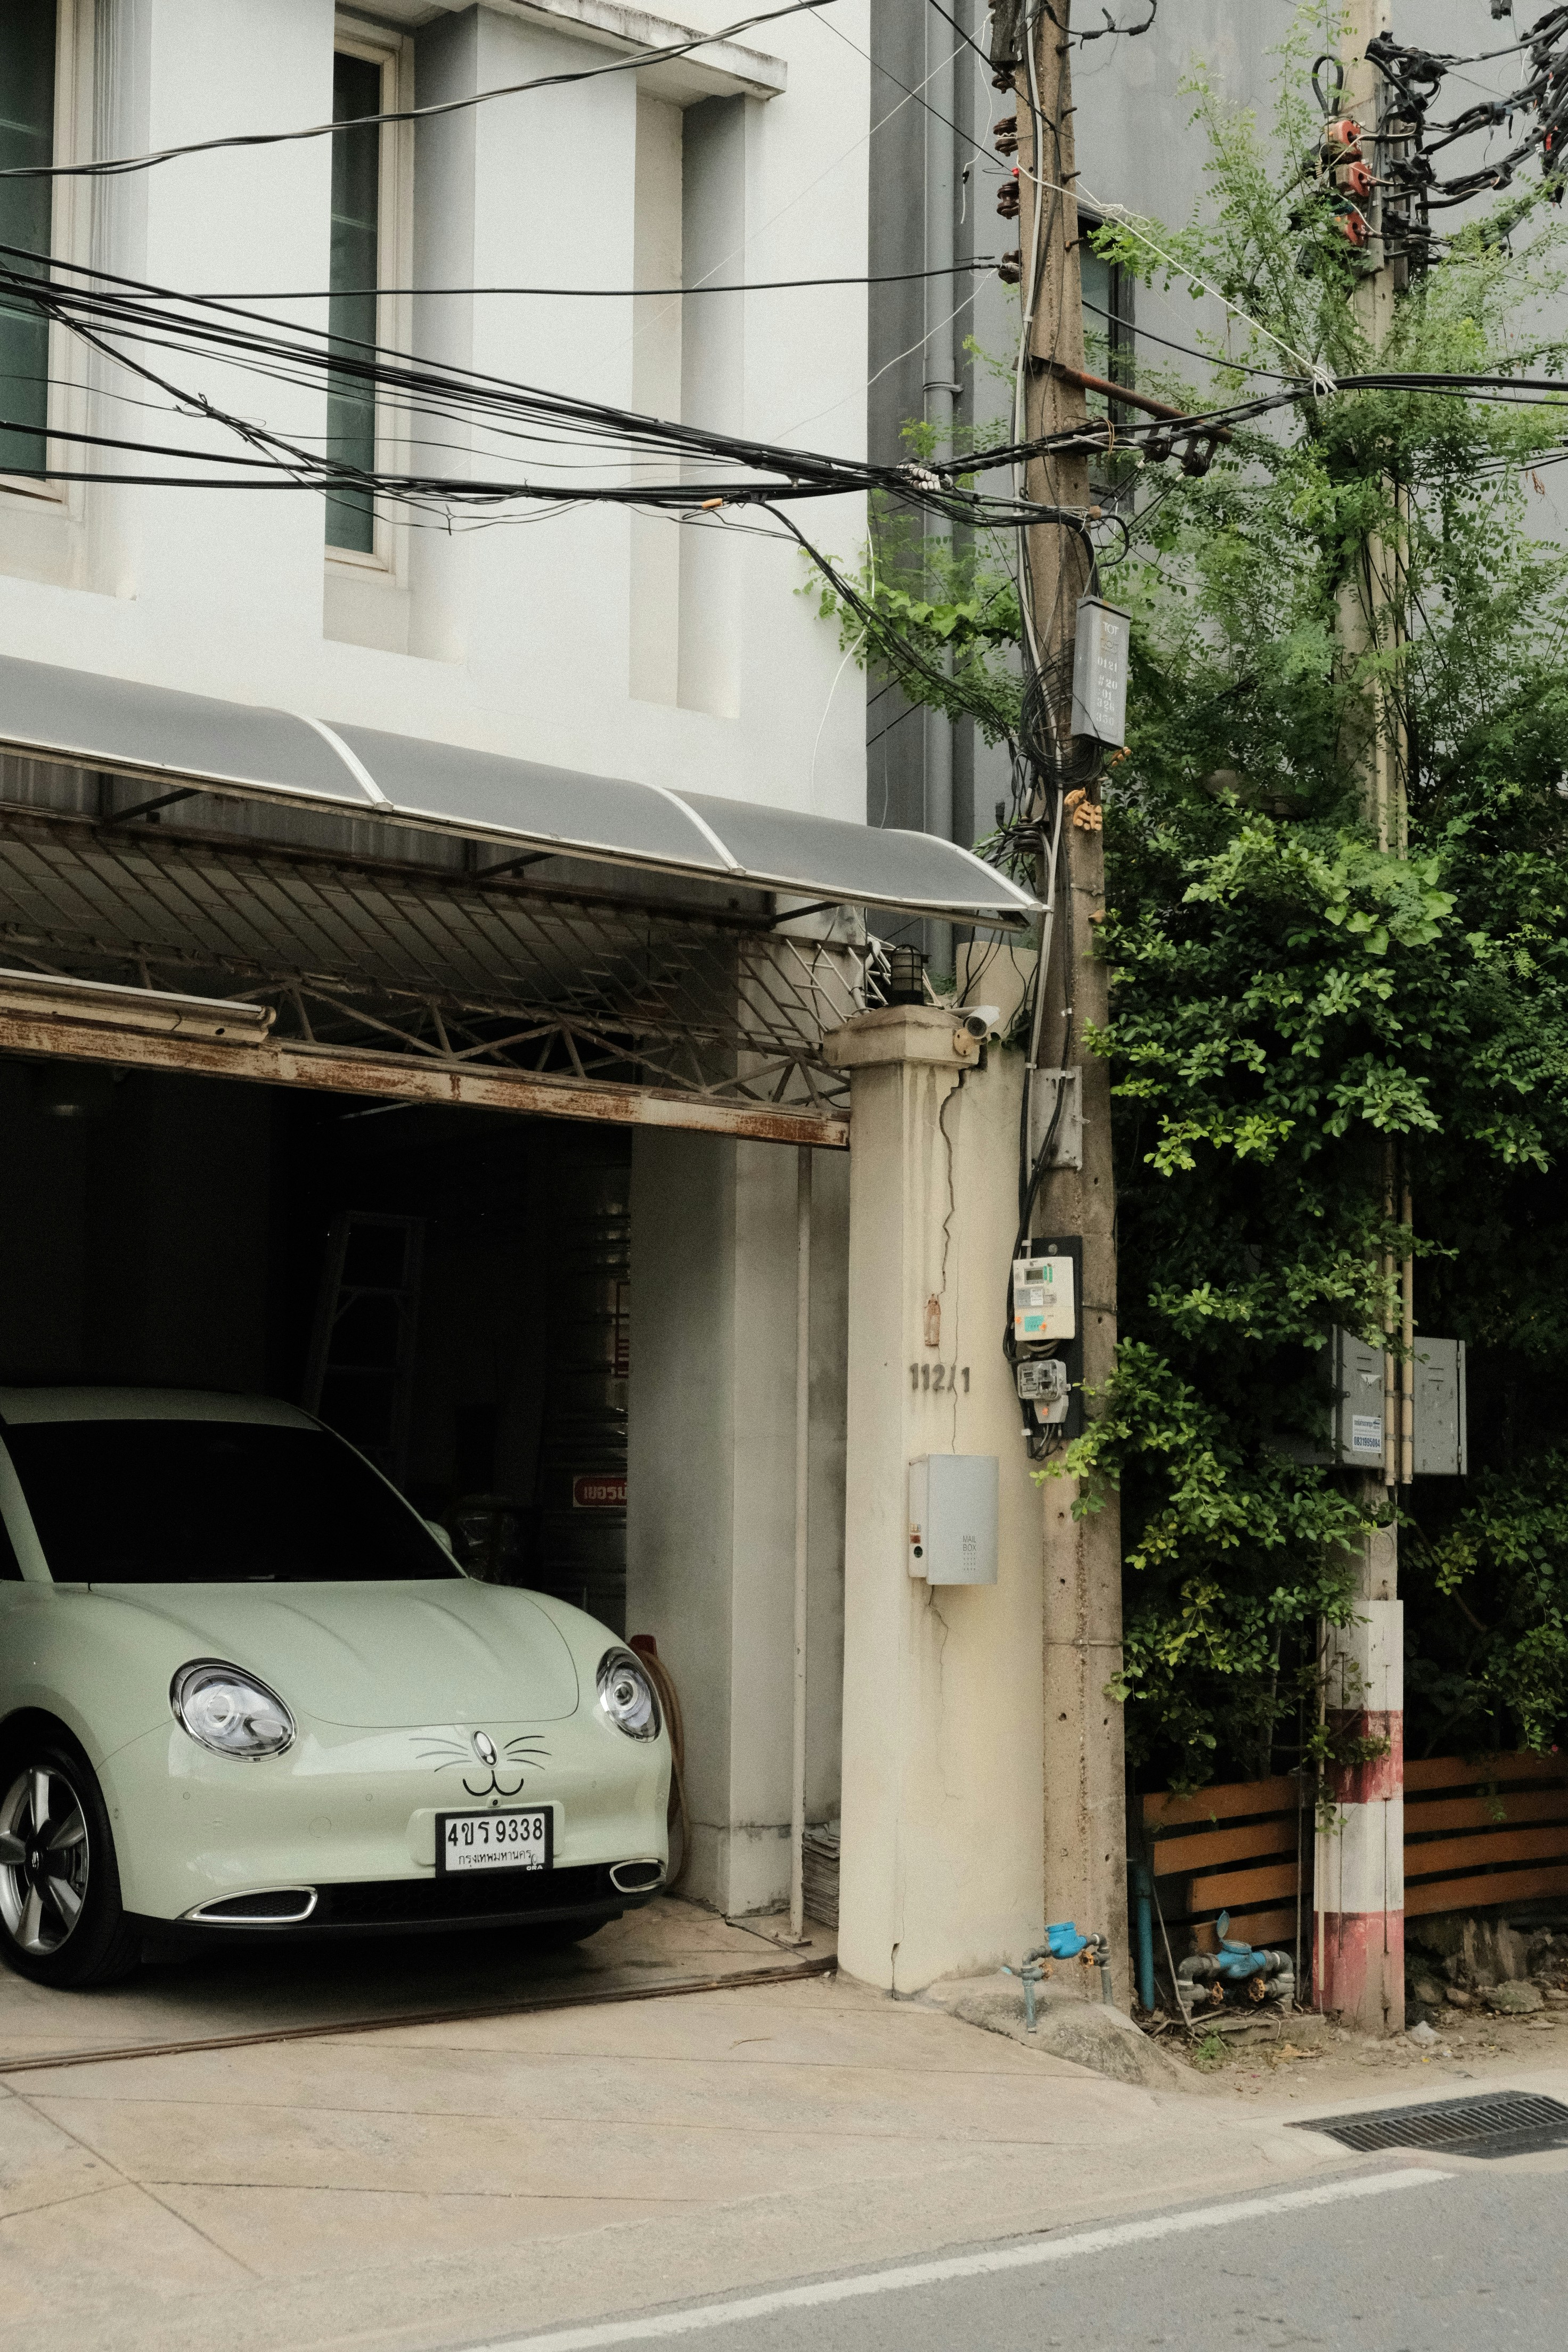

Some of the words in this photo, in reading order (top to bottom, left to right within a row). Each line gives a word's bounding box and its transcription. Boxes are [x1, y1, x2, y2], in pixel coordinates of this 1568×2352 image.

[1102, 622, 1120, 635] TOT
[1097, 657, 1117, 673] 0121
[910, 1363, 970, 1393] 112/1
[496, 1818, 543, 1843] 9338
[459, 1849, 532, 1867] กรุงเทพมหานคร
